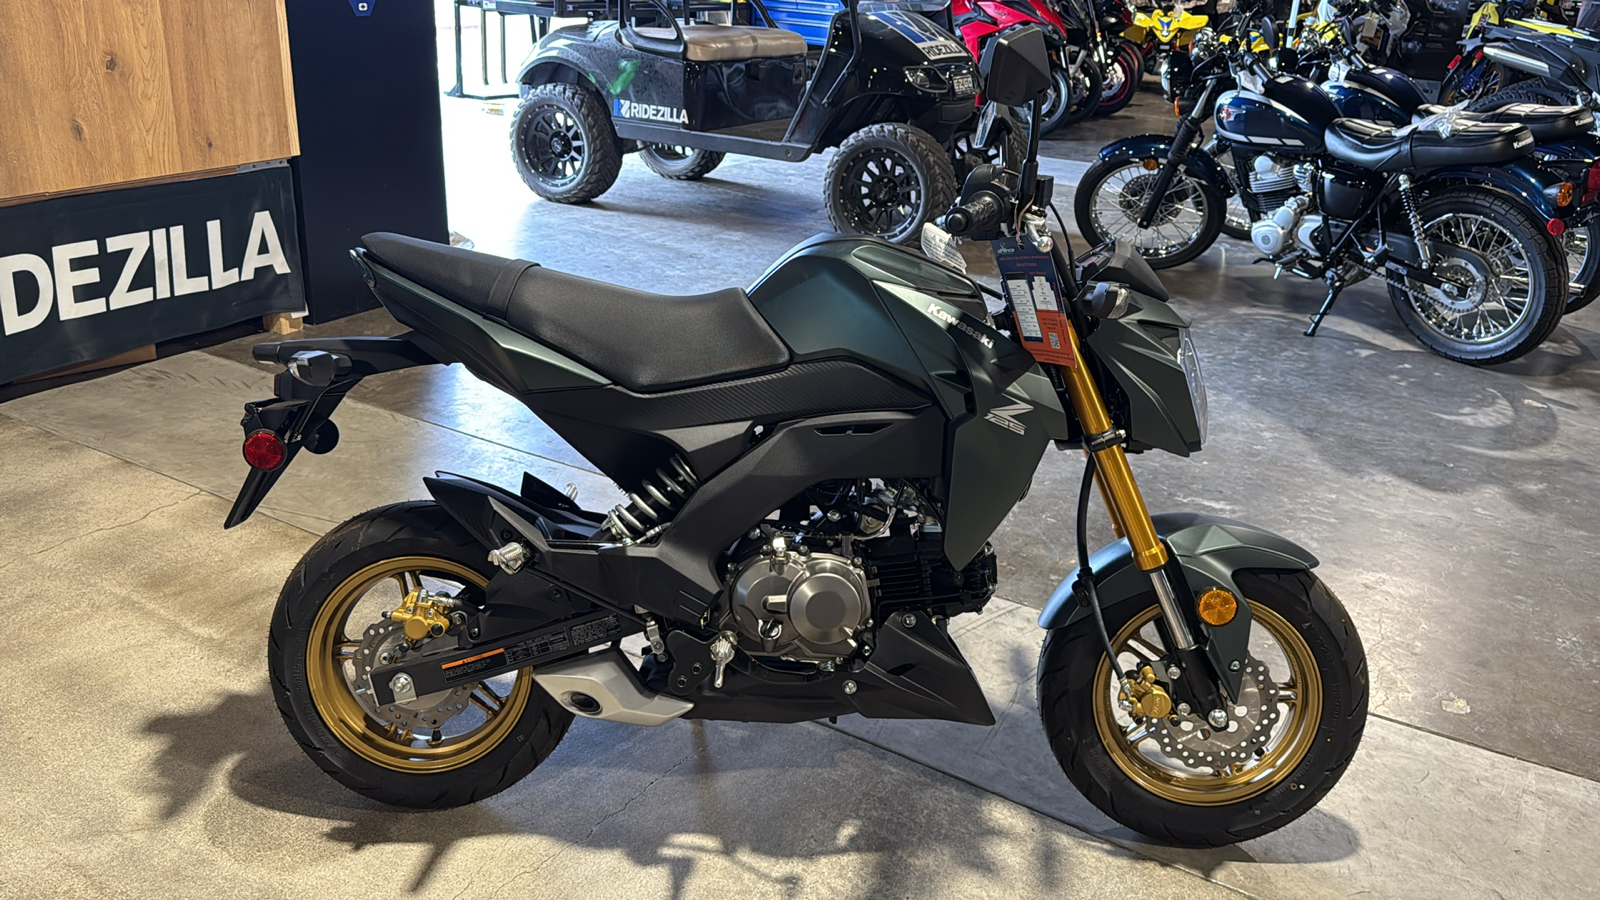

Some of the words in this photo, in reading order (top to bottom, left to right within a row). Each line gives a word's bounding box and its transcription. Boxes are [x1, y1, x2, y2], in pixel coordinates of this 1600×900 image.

[630, 102, 689, 124] RIDEZILLA
[938, 237, 960, 252] WARNIN
[0, 210, 291, 336] DEZILLA
[927, 303, 996, 349] Kawasaki
[983, 413, 1026, 435] 125
